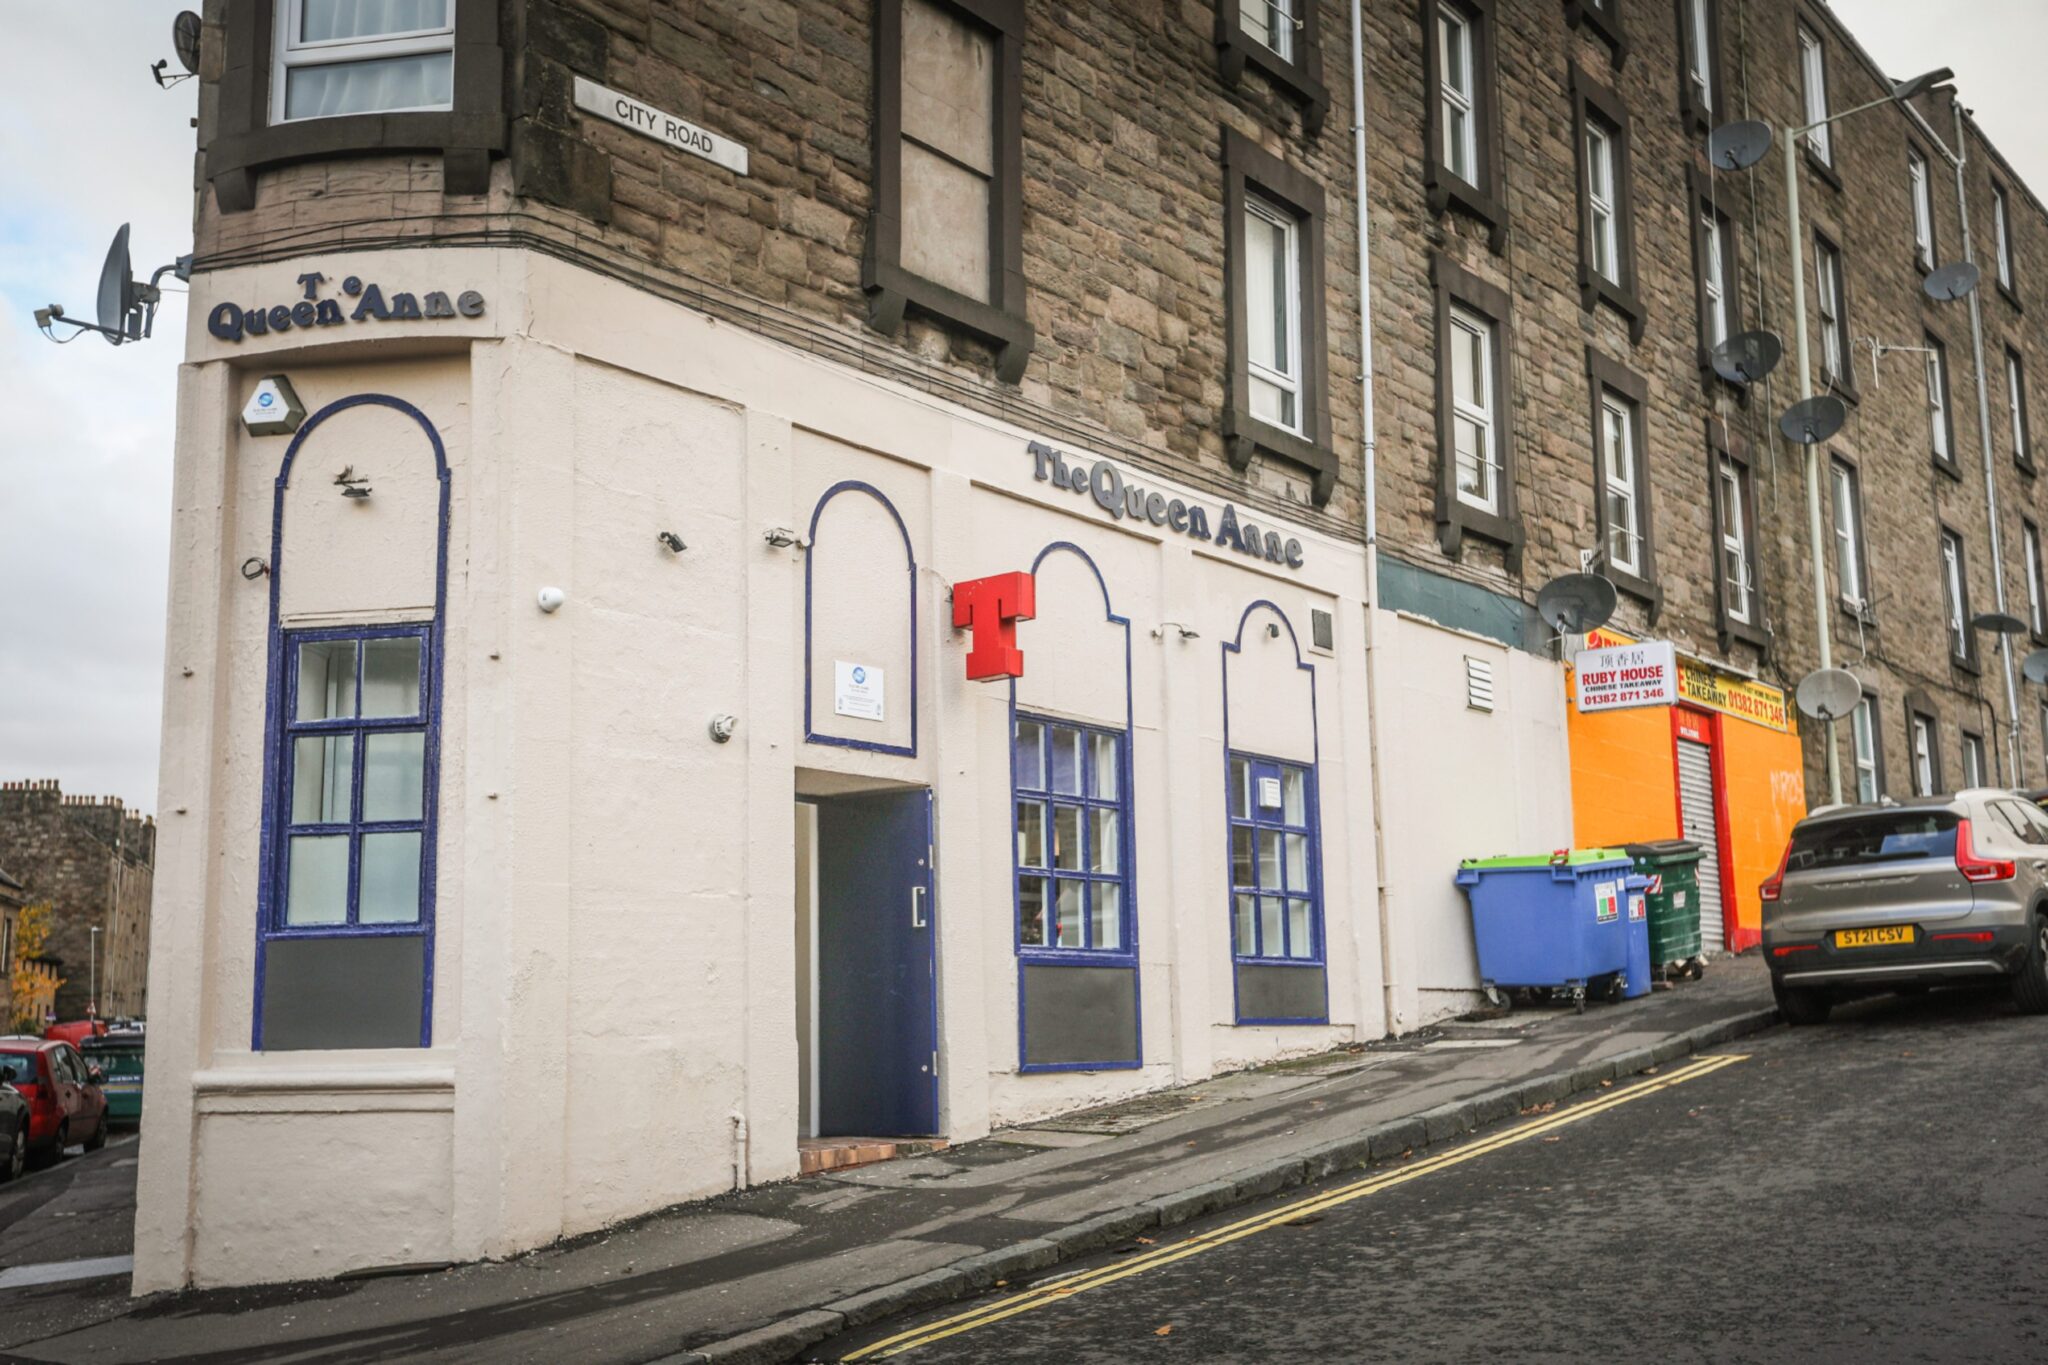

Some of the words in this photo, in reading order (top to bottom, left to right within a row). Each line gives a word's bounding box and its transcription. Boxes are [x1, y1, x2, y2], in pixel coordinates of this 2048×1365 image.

[615, 100, 657, 130] CITY
[665, 120, 713, 153] ROAD
[207, 298, 345, 342] Queen
[350, 283, 485, 320] Anne
[1027, 440, 1089, 494] The
[1090, 460, 1212, 540] Queen
[1215, 504, 1304, 569] Anne
[953, 571, 1036, 683] T
[1582, 670, 1617, 686] RUBY
[1620, 665, 1664, 681] HOUSE
[1585, 684, 1617, 693] CHINESE
[1620, 680, 1662, 689] TAKEAWAY
[1685, 664, 1717, 690] CHINESE
[1584, 693, 1617, 705] 01382
[1620, 691, 1640, 701] 871
[1643, 688, 1664, 699] 346
[1686, 681, 1727, 707] TAKEAWAY
[1728, 689, 1753, 714] 01382
[1754, 698, 1769, 719] 871
[1769, 704, 1784, 724] 346
[1844, 930, 1875, 945] ST21
[1878, 928, 1905, 942] CSV
